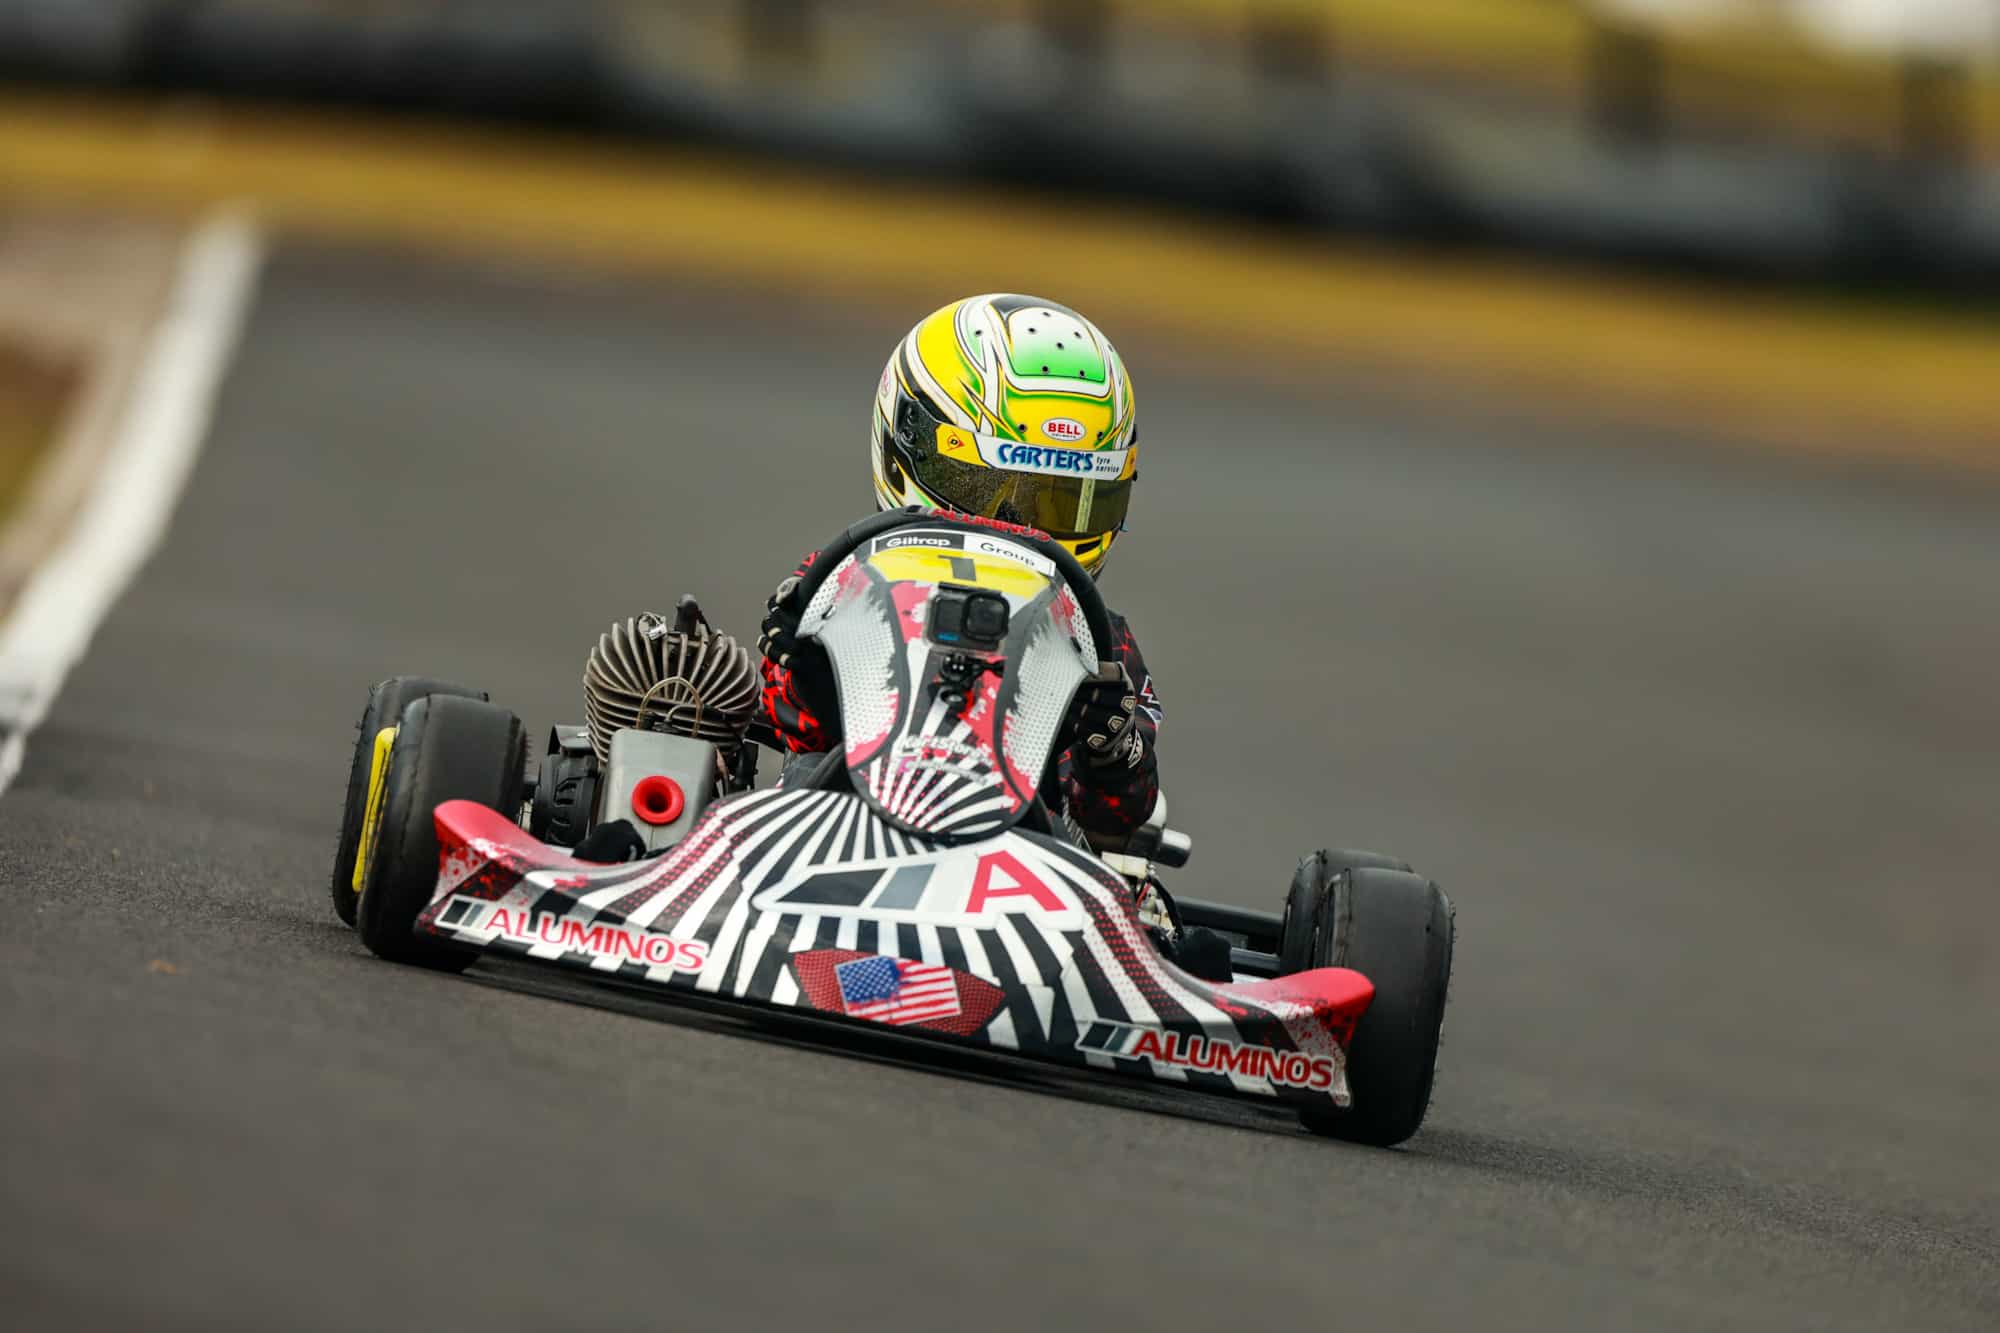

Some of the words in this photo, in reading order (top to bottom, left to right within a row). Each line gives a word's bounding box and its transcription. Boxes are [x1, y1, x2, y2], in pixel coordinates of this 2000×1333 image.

[1048, 422, 1081, 436] BELL
[998, 443, 1093, 472] CARTER'S
[886, 535, 951, 548] Giltrap
[980, 542, 1036, 568] Group
[964, 849, 1069, 914] A
[484, 907, 705, 970] ALUMINOS
[1131, 1030, 1333, 1088] ALUMINOS
